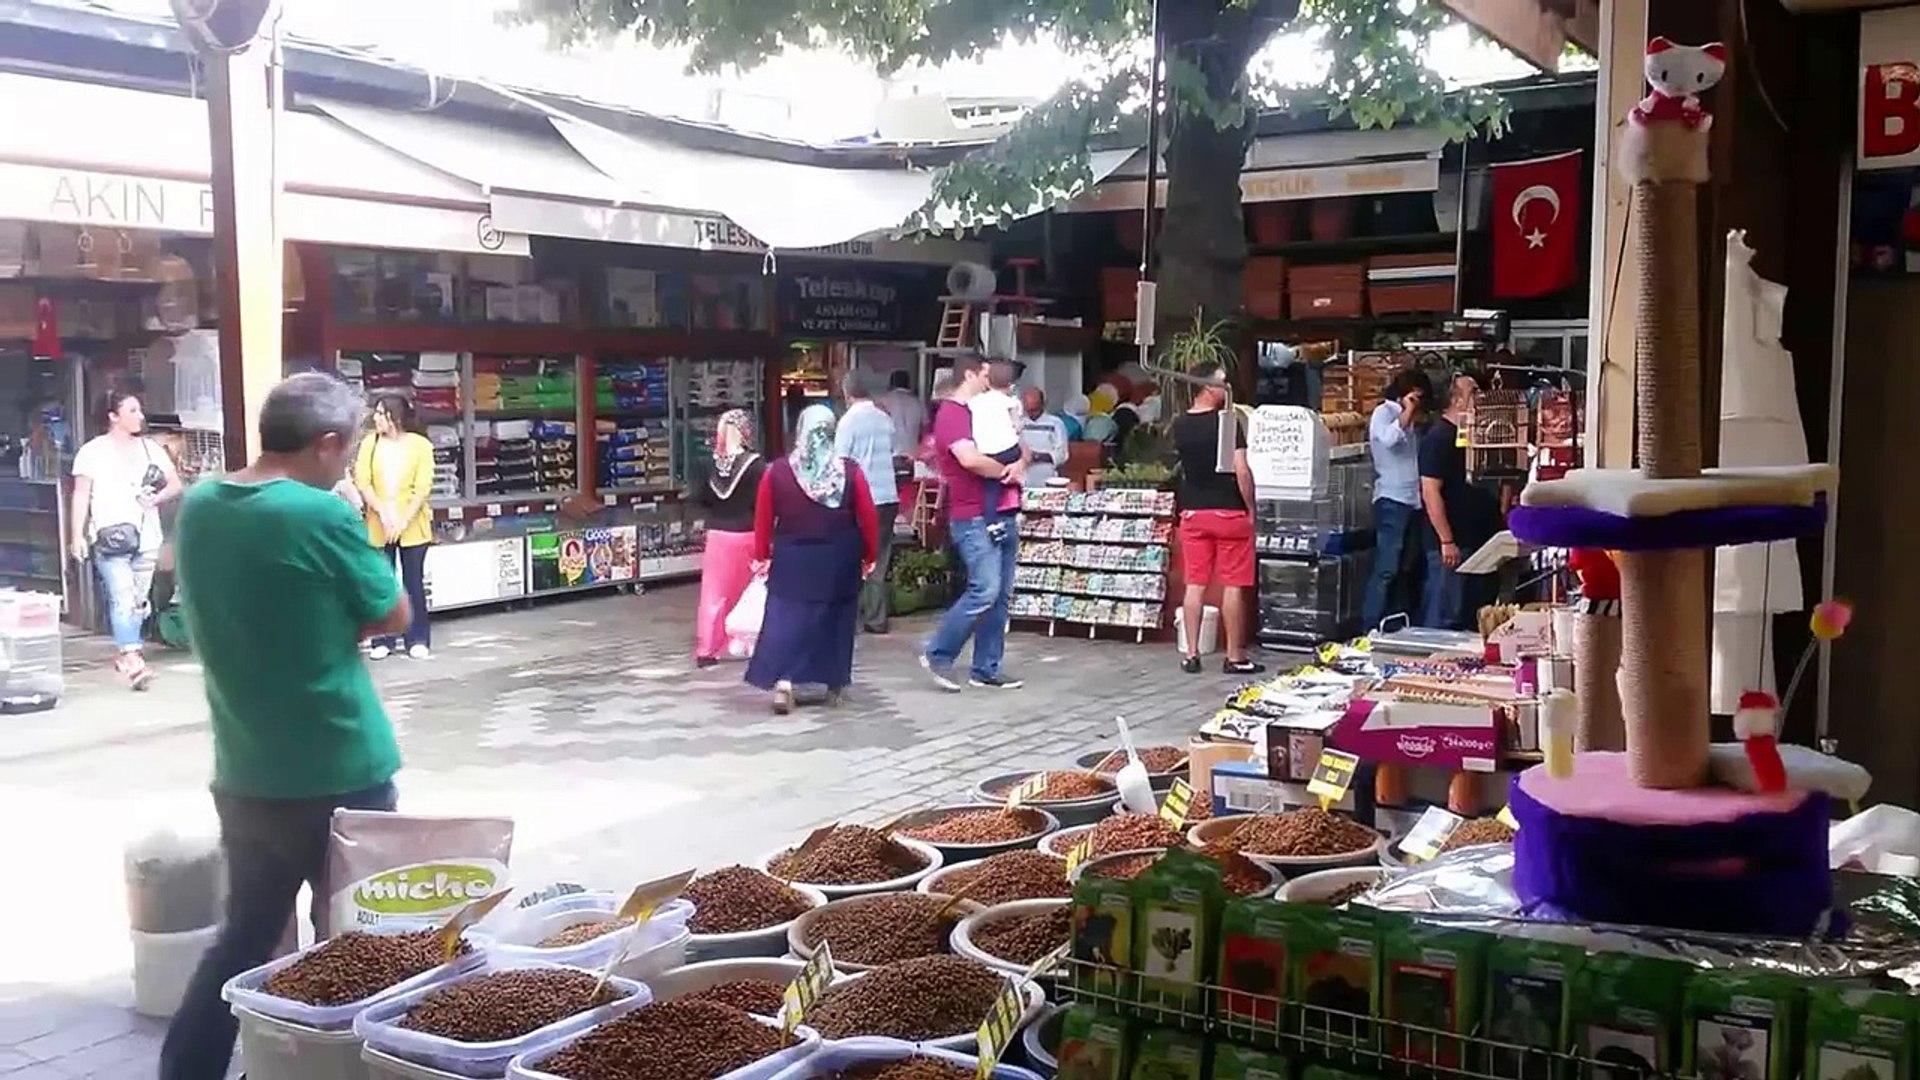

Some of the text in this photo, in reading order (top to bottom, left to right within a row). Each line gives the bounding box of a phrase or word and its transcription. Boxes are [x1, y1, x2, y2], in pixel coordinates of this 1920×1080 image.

[51, 176, 164, 223] AKIN
[358, 872, 491, 900] micho
[356, 910, 380, 926] ADULT
